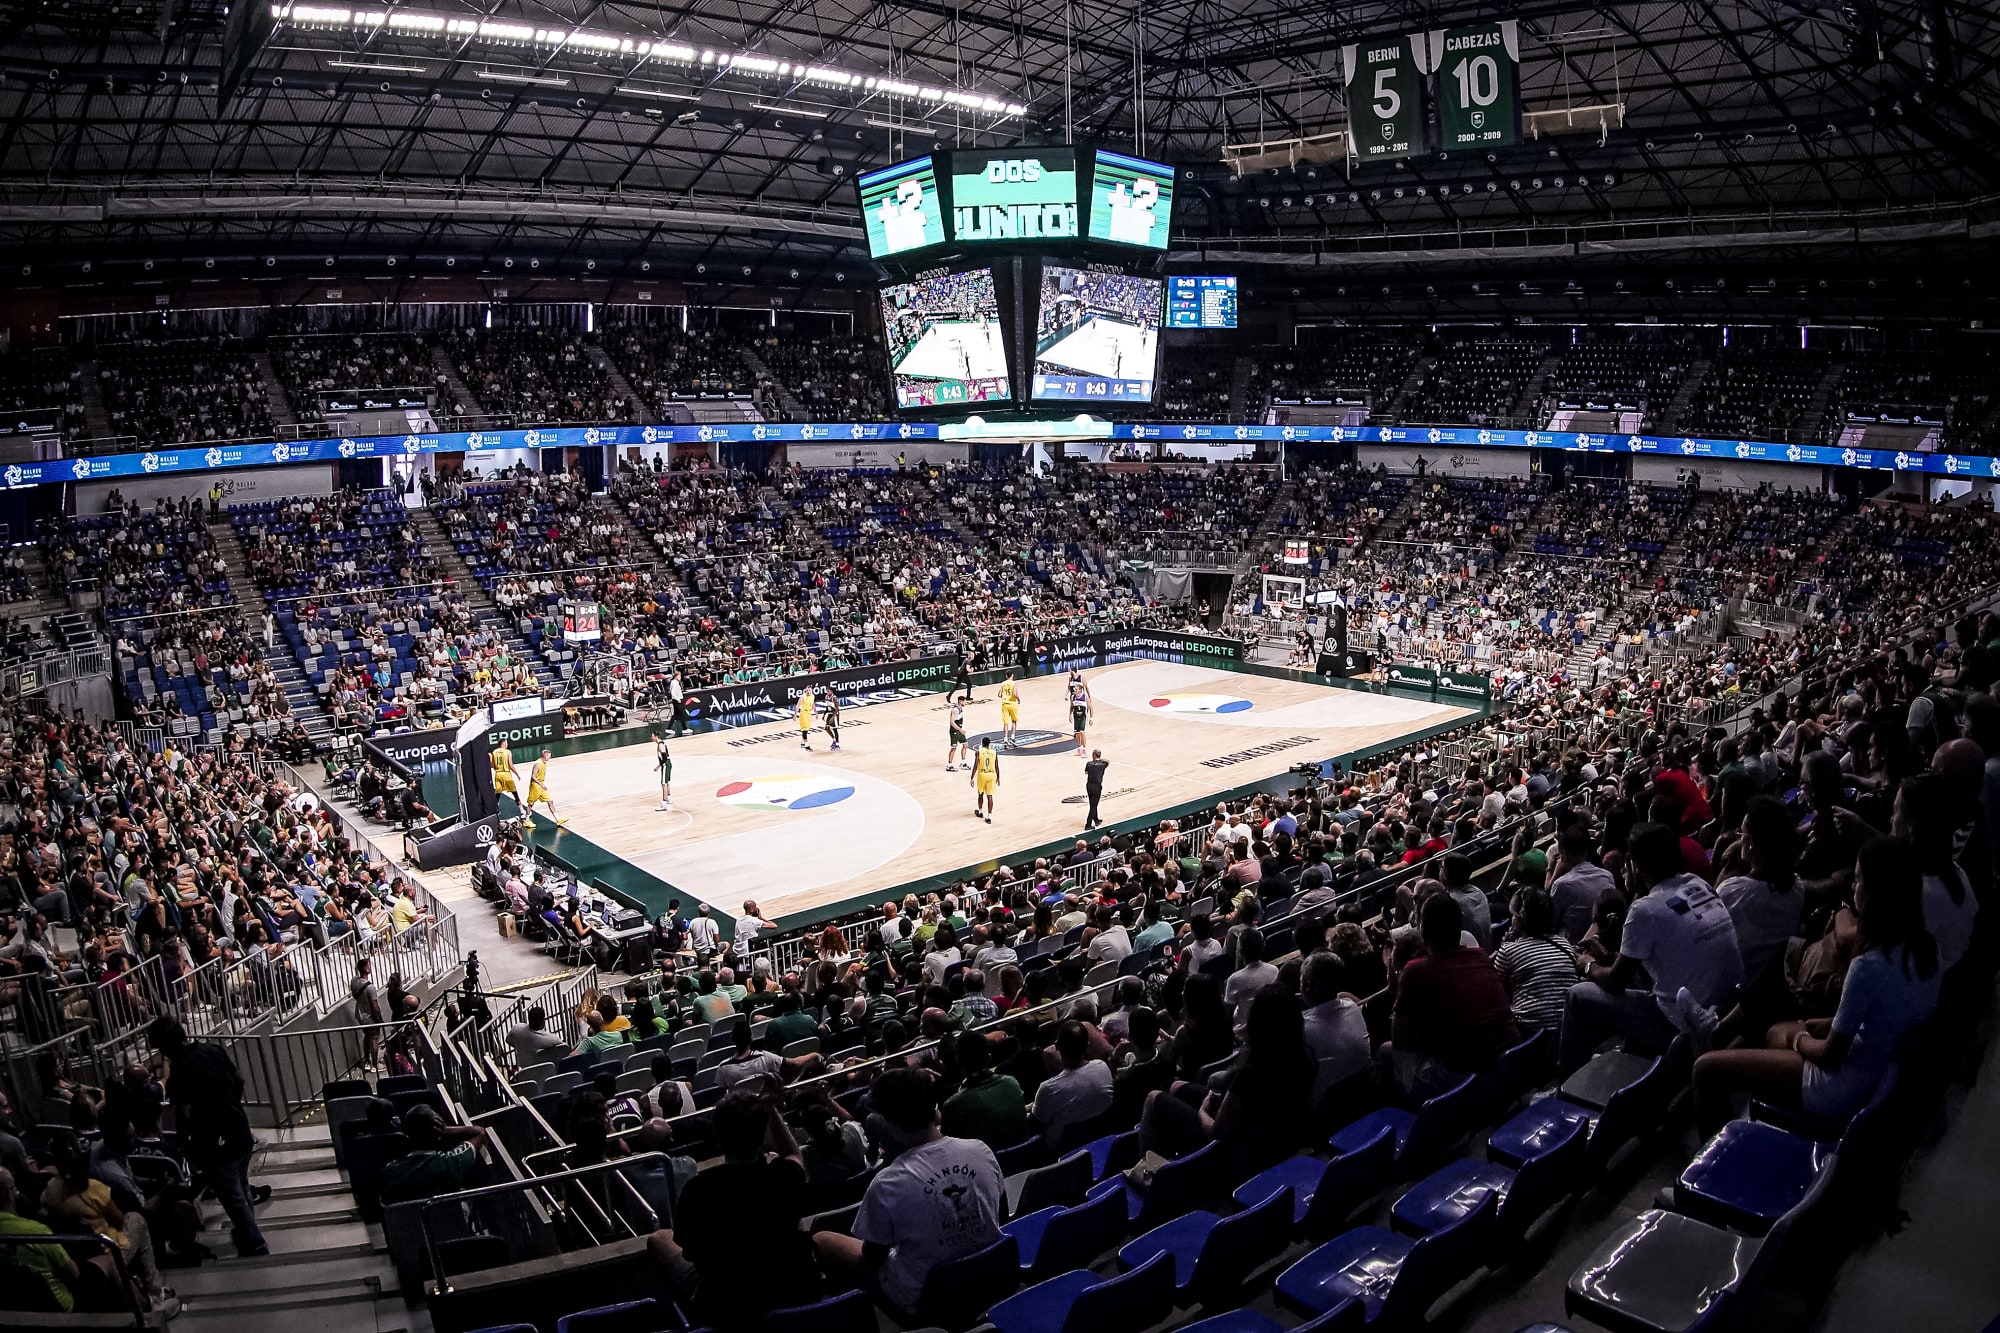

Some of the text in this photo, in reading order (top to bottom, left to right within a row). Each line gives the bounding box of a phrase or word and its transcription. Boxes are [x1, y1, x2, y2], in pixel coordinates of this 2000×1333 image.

[1446, 32, 1501, 51] CABEZAS
[1367, 46, 1400, 64] BERNI
[1451, 55, 1499, 109] 10
[1372, 67, 1401, 119] 5
[1457, 133, 1476, 142] 2000
[1484, 131, 1502, 140] 2009
[1370, 146, 1386, 154] 1999
[1392, 142, 1408, 152] 2012
[986, 159, 1041, 183] DOS
[942, 386, 962, 399] 9:43
[1065, 382, 1076, 394] 75
[1086, 382, 1106, 395] 9:43
[1113, 384, 1124, 394] 54
[1286, 548, 1308, 558] 24 24
[564, 616, 596, 632] 24 24
[1052, 635, 1234, 658] Andalucía Región Europea del DEPORTE
[708, 688, 775, 713] Andalucía
[878, 672, 895, 684] del
[897, 664, 950, 682] DEPORTE
[488, 724, 552, 745] EPORTE
[384, 742, 448, 760] Europea
[924, 1164, 976, 1194] CHINGÓN
